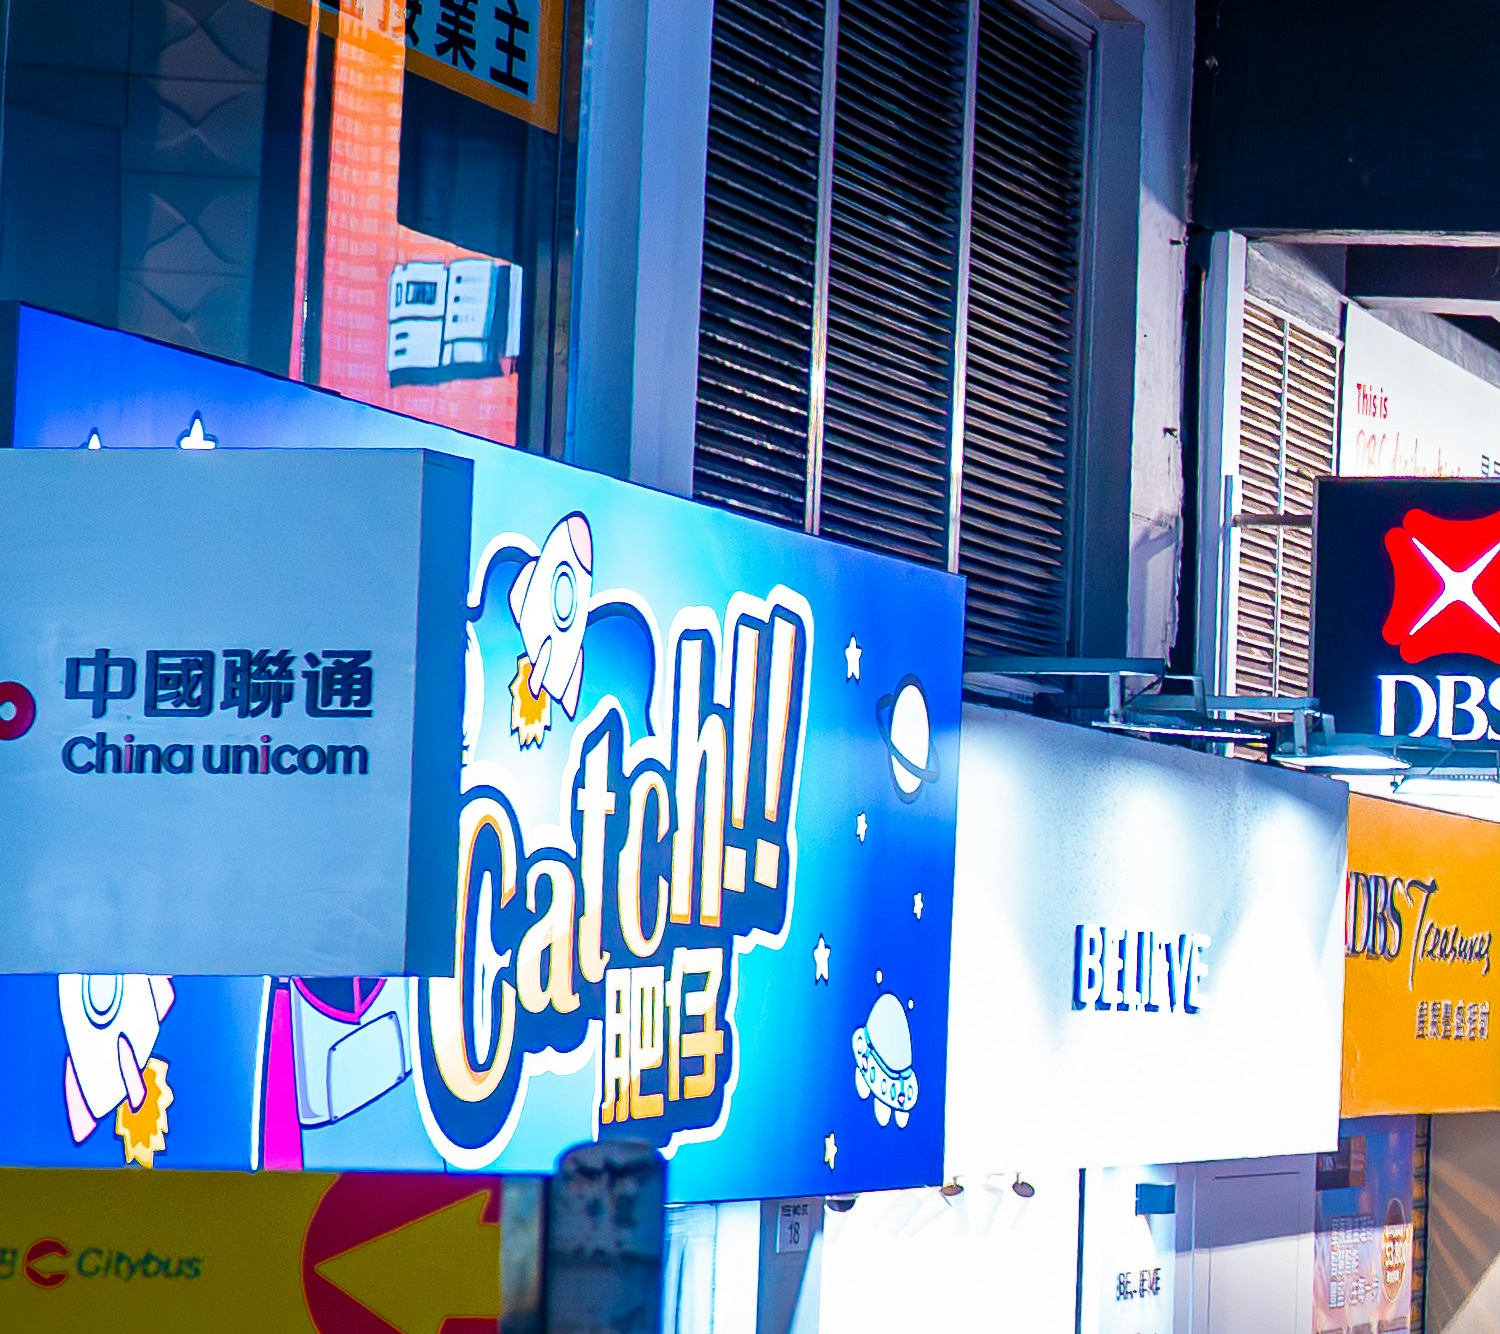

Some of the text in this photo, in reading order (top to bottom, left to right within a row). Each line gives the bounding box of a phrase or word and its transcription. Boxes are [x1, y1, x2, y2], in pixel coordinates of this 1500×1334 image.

[1357, 383, 1388, 419] This is
[64, 648, 374, 718] 中國聯通
[62, 732, 368, 775] China unicom
[1347, 871, 1492, 991] DBS Treasures
[601, 947, 724, 1124] 肥仔
[76, 1248, 201, 1280] Citybus
